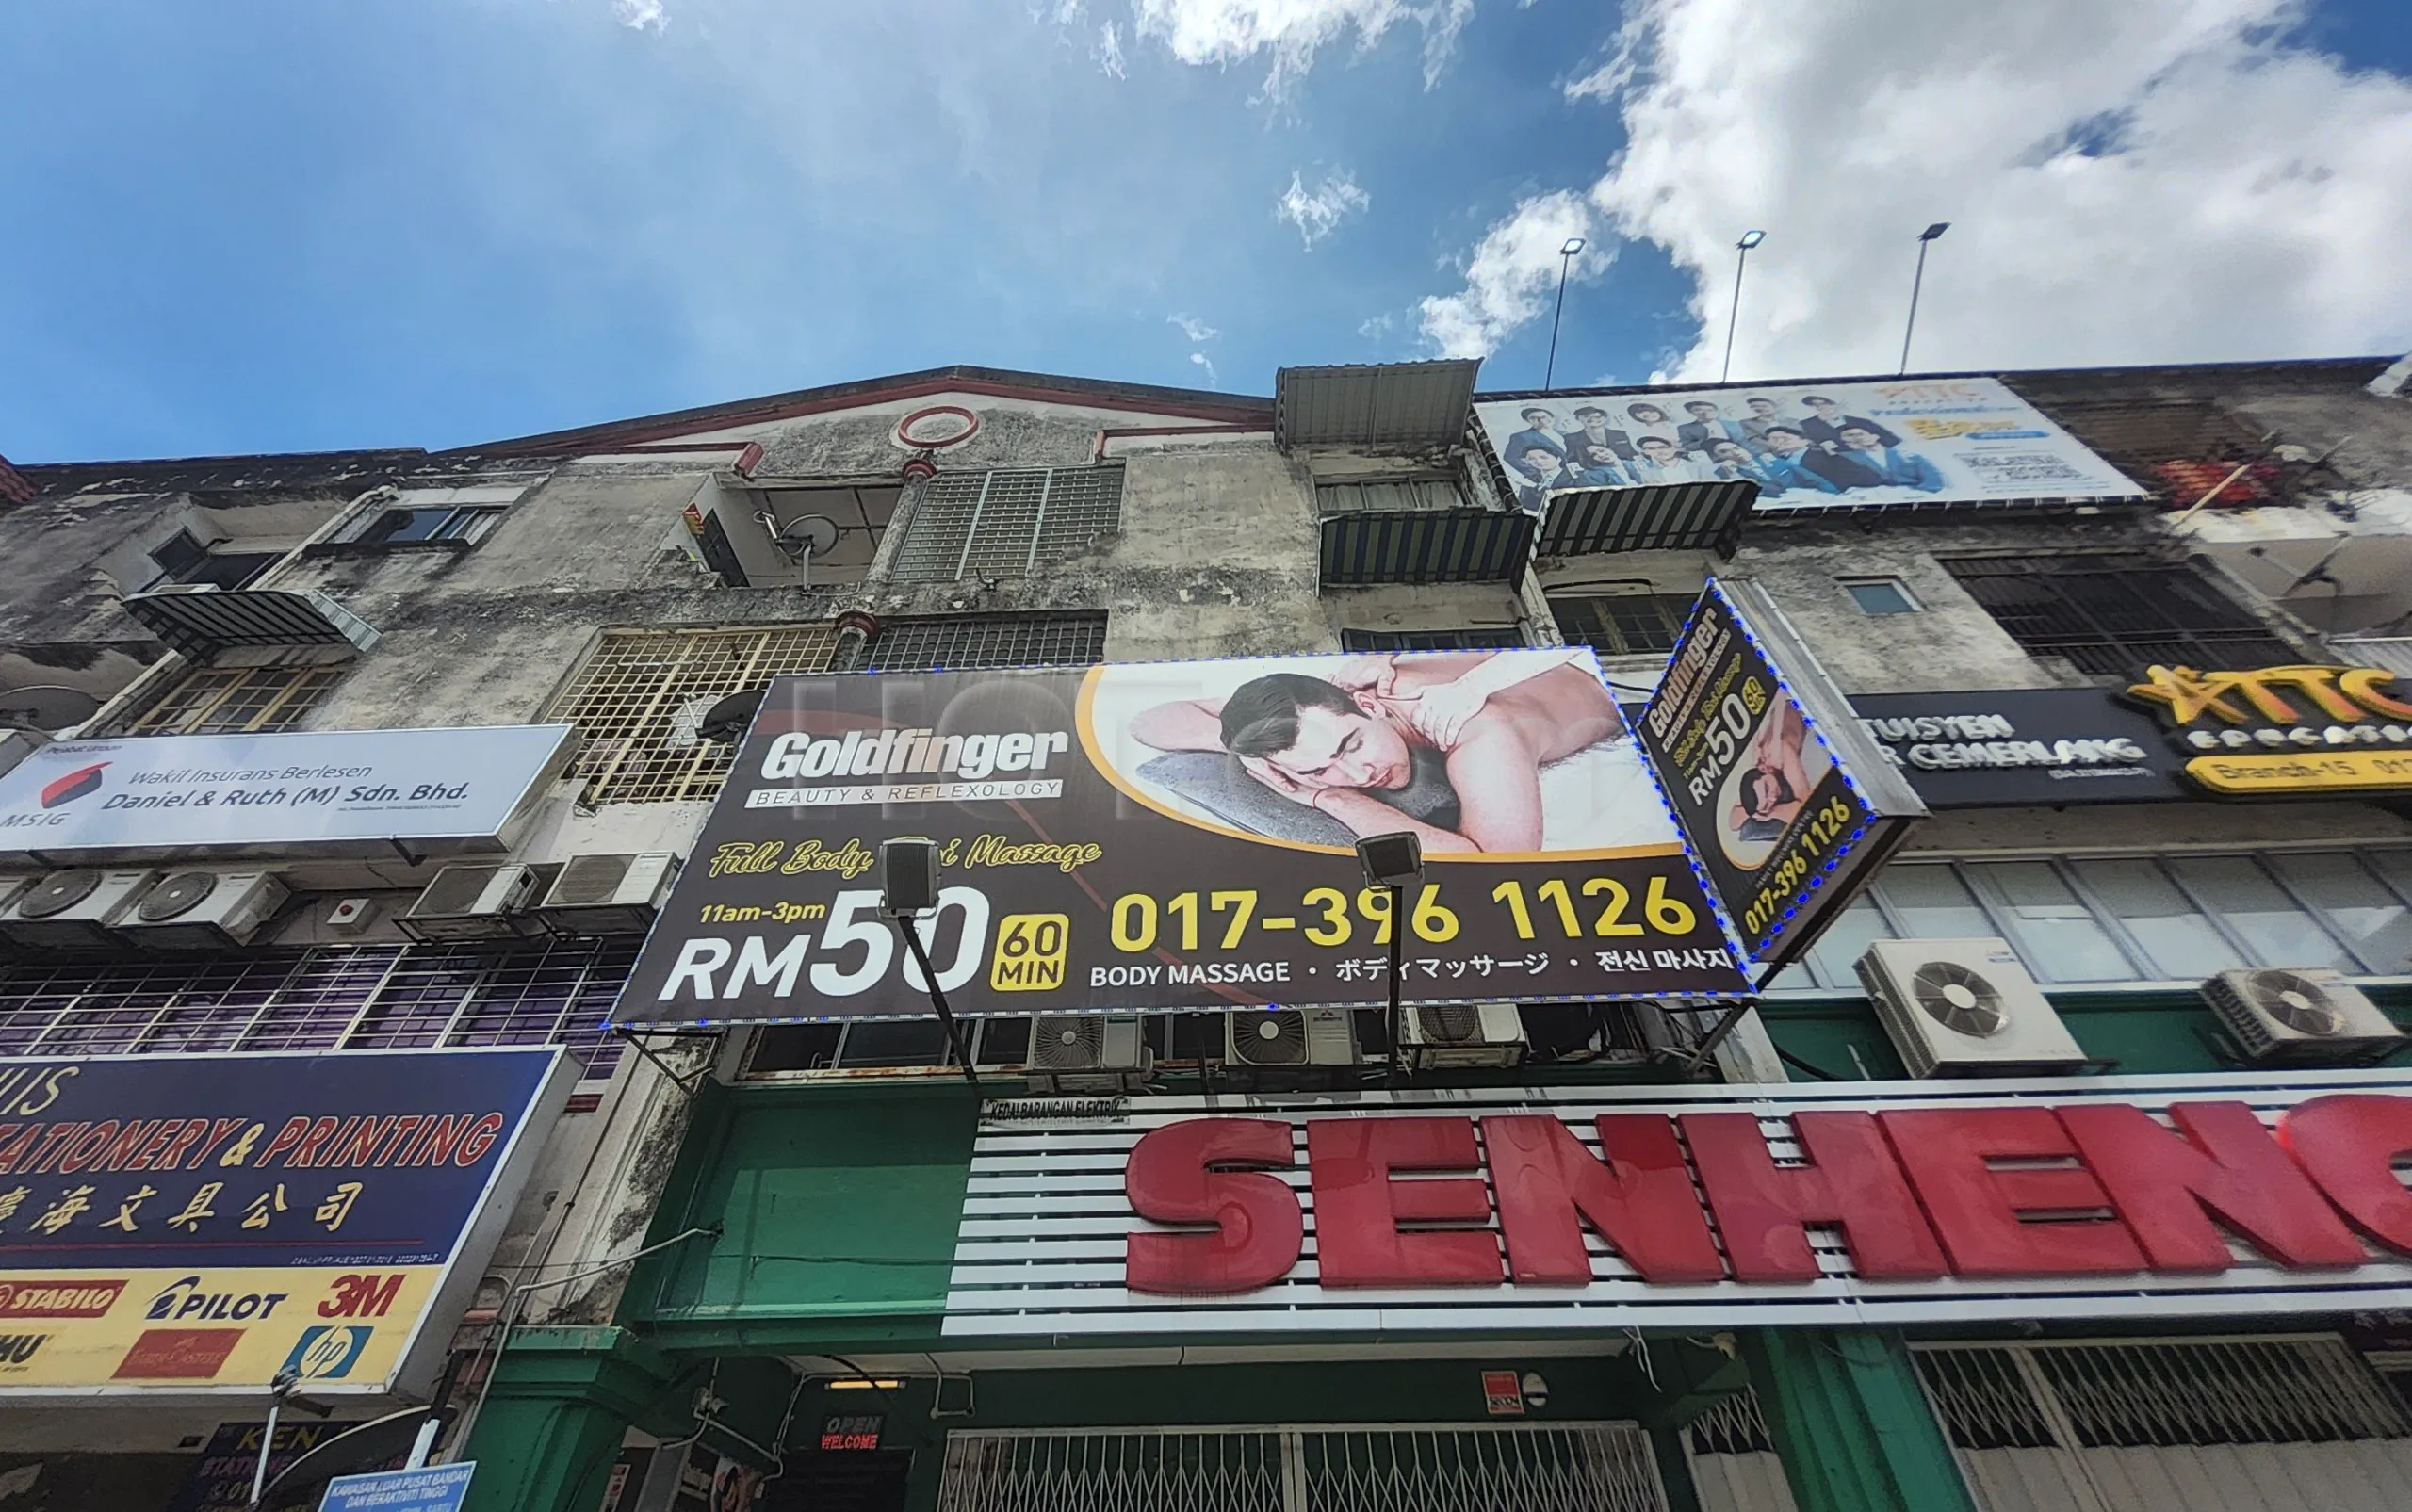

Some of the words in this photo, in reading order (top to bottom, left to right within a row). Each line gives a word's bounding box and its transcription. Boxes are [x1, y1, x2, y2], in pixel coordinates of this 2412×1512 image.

[1648, 607, 1719, 739] Goldfinger
[760, 728, 1068, 780] Goldfinger
[128, 768, 191, 785] Wakil
[188, 768, 279, 783] Insurans
[280, 765, 372, 780] Berlesen
[100, 789, 197, 810] Daniel
[193, 791, 218, 806] &
[219, 787, 287, 806] Ruth
[290, 785, 340, 807] (M)
[344, 783, 401, 802] Sdn.
[408, 781, 470, 800] Bhd.
[756, 789, 851, 805] BEAUTY
[861, 788, 875, 801] &
[888, 781, 1060, 801] REFLEXOLOGY
[0, 811, 71, 828] MSIG
[709, 840, 779, 879] Full
[781, 837, 875, 880] Body
[964, 834, 1102, 873] Massage
[1745, 849, 1807, 935] 017-396
[1801, 795, 1850, 856] 1126
[699, 902, 826, 924] 11am-3pm
[1110, 884, 1459, 952] 017-396
[1491, 876, 1696, 939] 1126
[1002, 920, 1063, 958] 60
[997, 959, 1060, 984] MIN
[1336, 951, 1550, 982] ボディマッサージ
[1596, 949, 1647, 972] 전신
[1654, 947, 1735, 971] 마사지
[1090, 964, 1161, 987] BODY
[1168, 961, 1290, 985] MASSAGE
[1019, 1100, 1074, 1119] BARANGAN
[0, 1117, 249, 1175] ATIONERY
[220, 1122, 265, 1168] &
[253, 1112, 503, 1168] PRINTING
[11, 1287, 116, 1310] STABILO
[173, 1293, 289, 1321] PILOT
[318, 1274, 406, 1318] 3M
[0, 1334, 48, 1364] HU
[235, 1425, 323, 1451] KEN
[826, 1416, 883, 1433] OPEN
[821, 1433, 878, 1449] WELCOME
